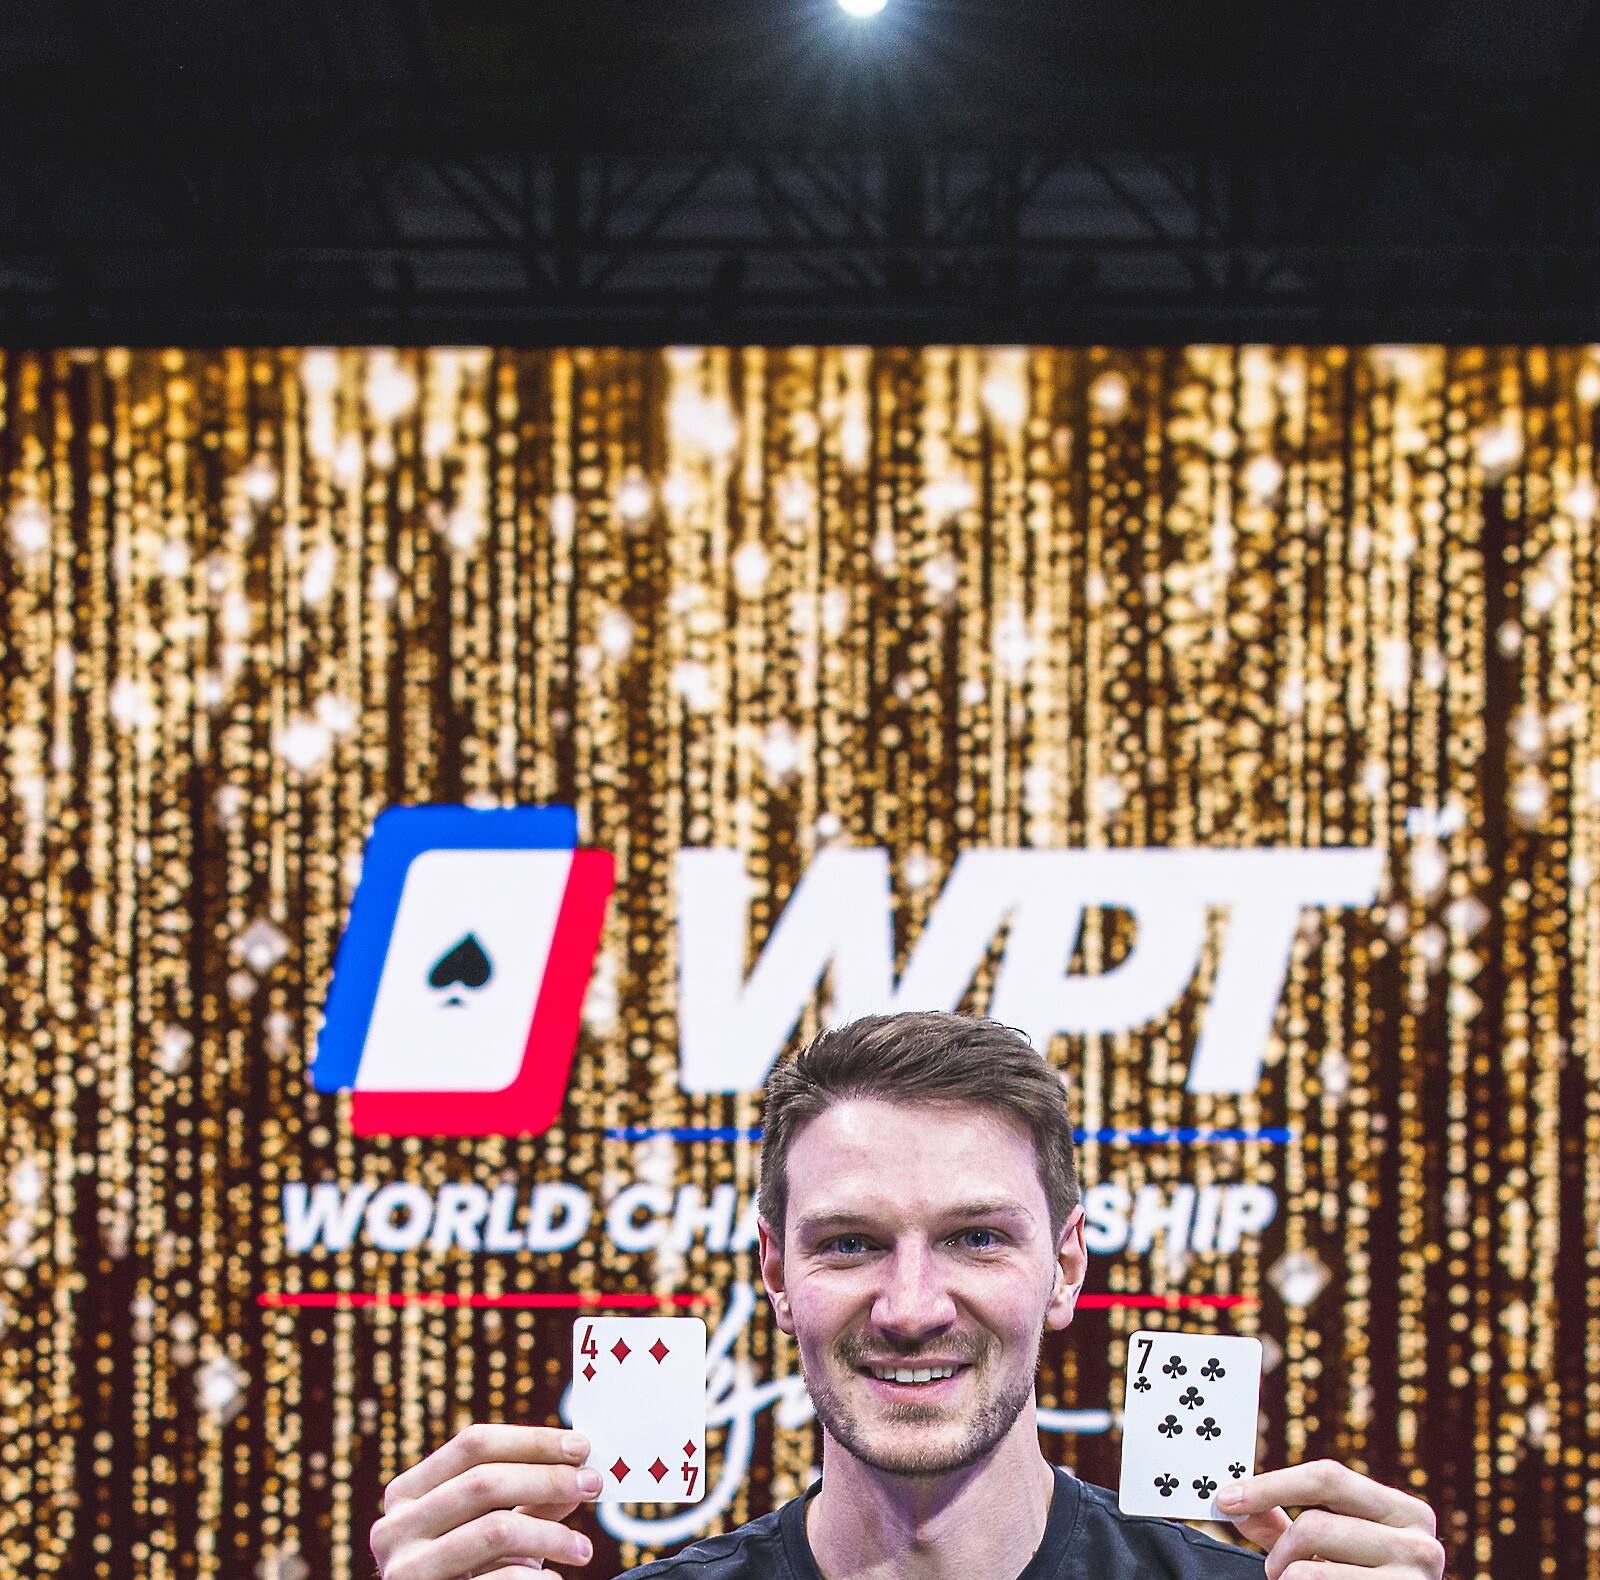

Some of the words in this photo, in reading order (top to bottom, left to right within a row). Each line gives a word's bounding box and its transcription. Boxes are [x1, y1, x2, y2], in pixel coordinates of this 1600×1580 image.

[676, 847, 1381, 1093] WPT
[283, 1182, 590, 1253] WORLD
[581, 1325, 598, 1359] 4
[1137, 1339, 1153, 1374] 7
[681, 1461, 699, 1496] 4
